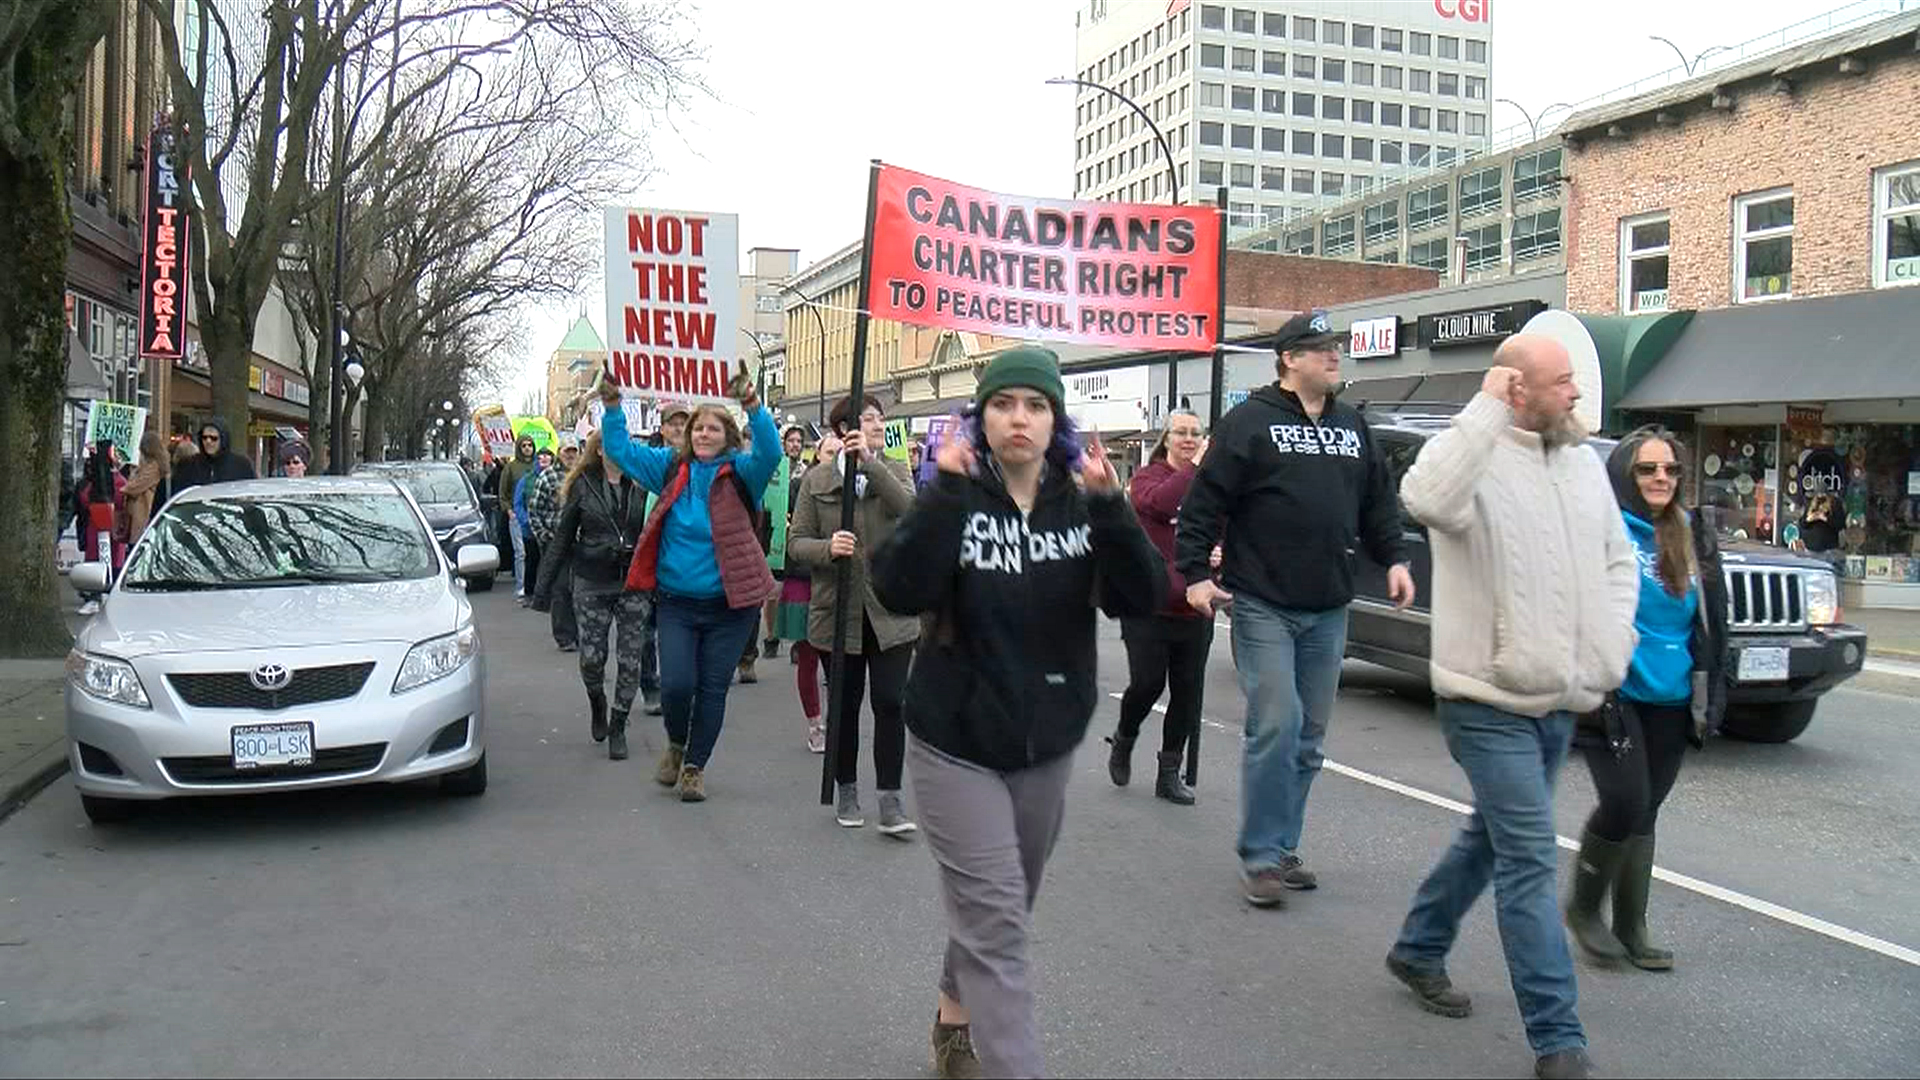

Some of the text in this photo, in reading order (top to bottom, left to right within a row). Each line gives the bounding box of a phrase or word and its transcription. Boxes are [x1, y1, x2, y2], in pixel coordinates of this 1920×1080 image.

[1435, 0, 1488, 23] CGI
[628, 214, 709, 257] NOT
[906, 186, 1196, 254] CANADIANS
[151, 207, 177, 351] TECTORIA
[632, 261, 707, 304] THE
[913, 234, 1188, 299] CHARTER RIGHT
[625, 306, 716, 351] NEW
[888, 280, 1207, 337] TO PEACEFUL PROTEST
[1438, 313, 1496, 338] CLOUD NINE
[613, 351, 733, 398] NORMAL
[96, 421, 132, 438] LYING
[111, 405, 135, 421] YOUR
[1269, 424, 1361, 449] FREEDOM
[1802, 466, 1841, 491] ditch
[960, 539, 1022, 574] PLAN
